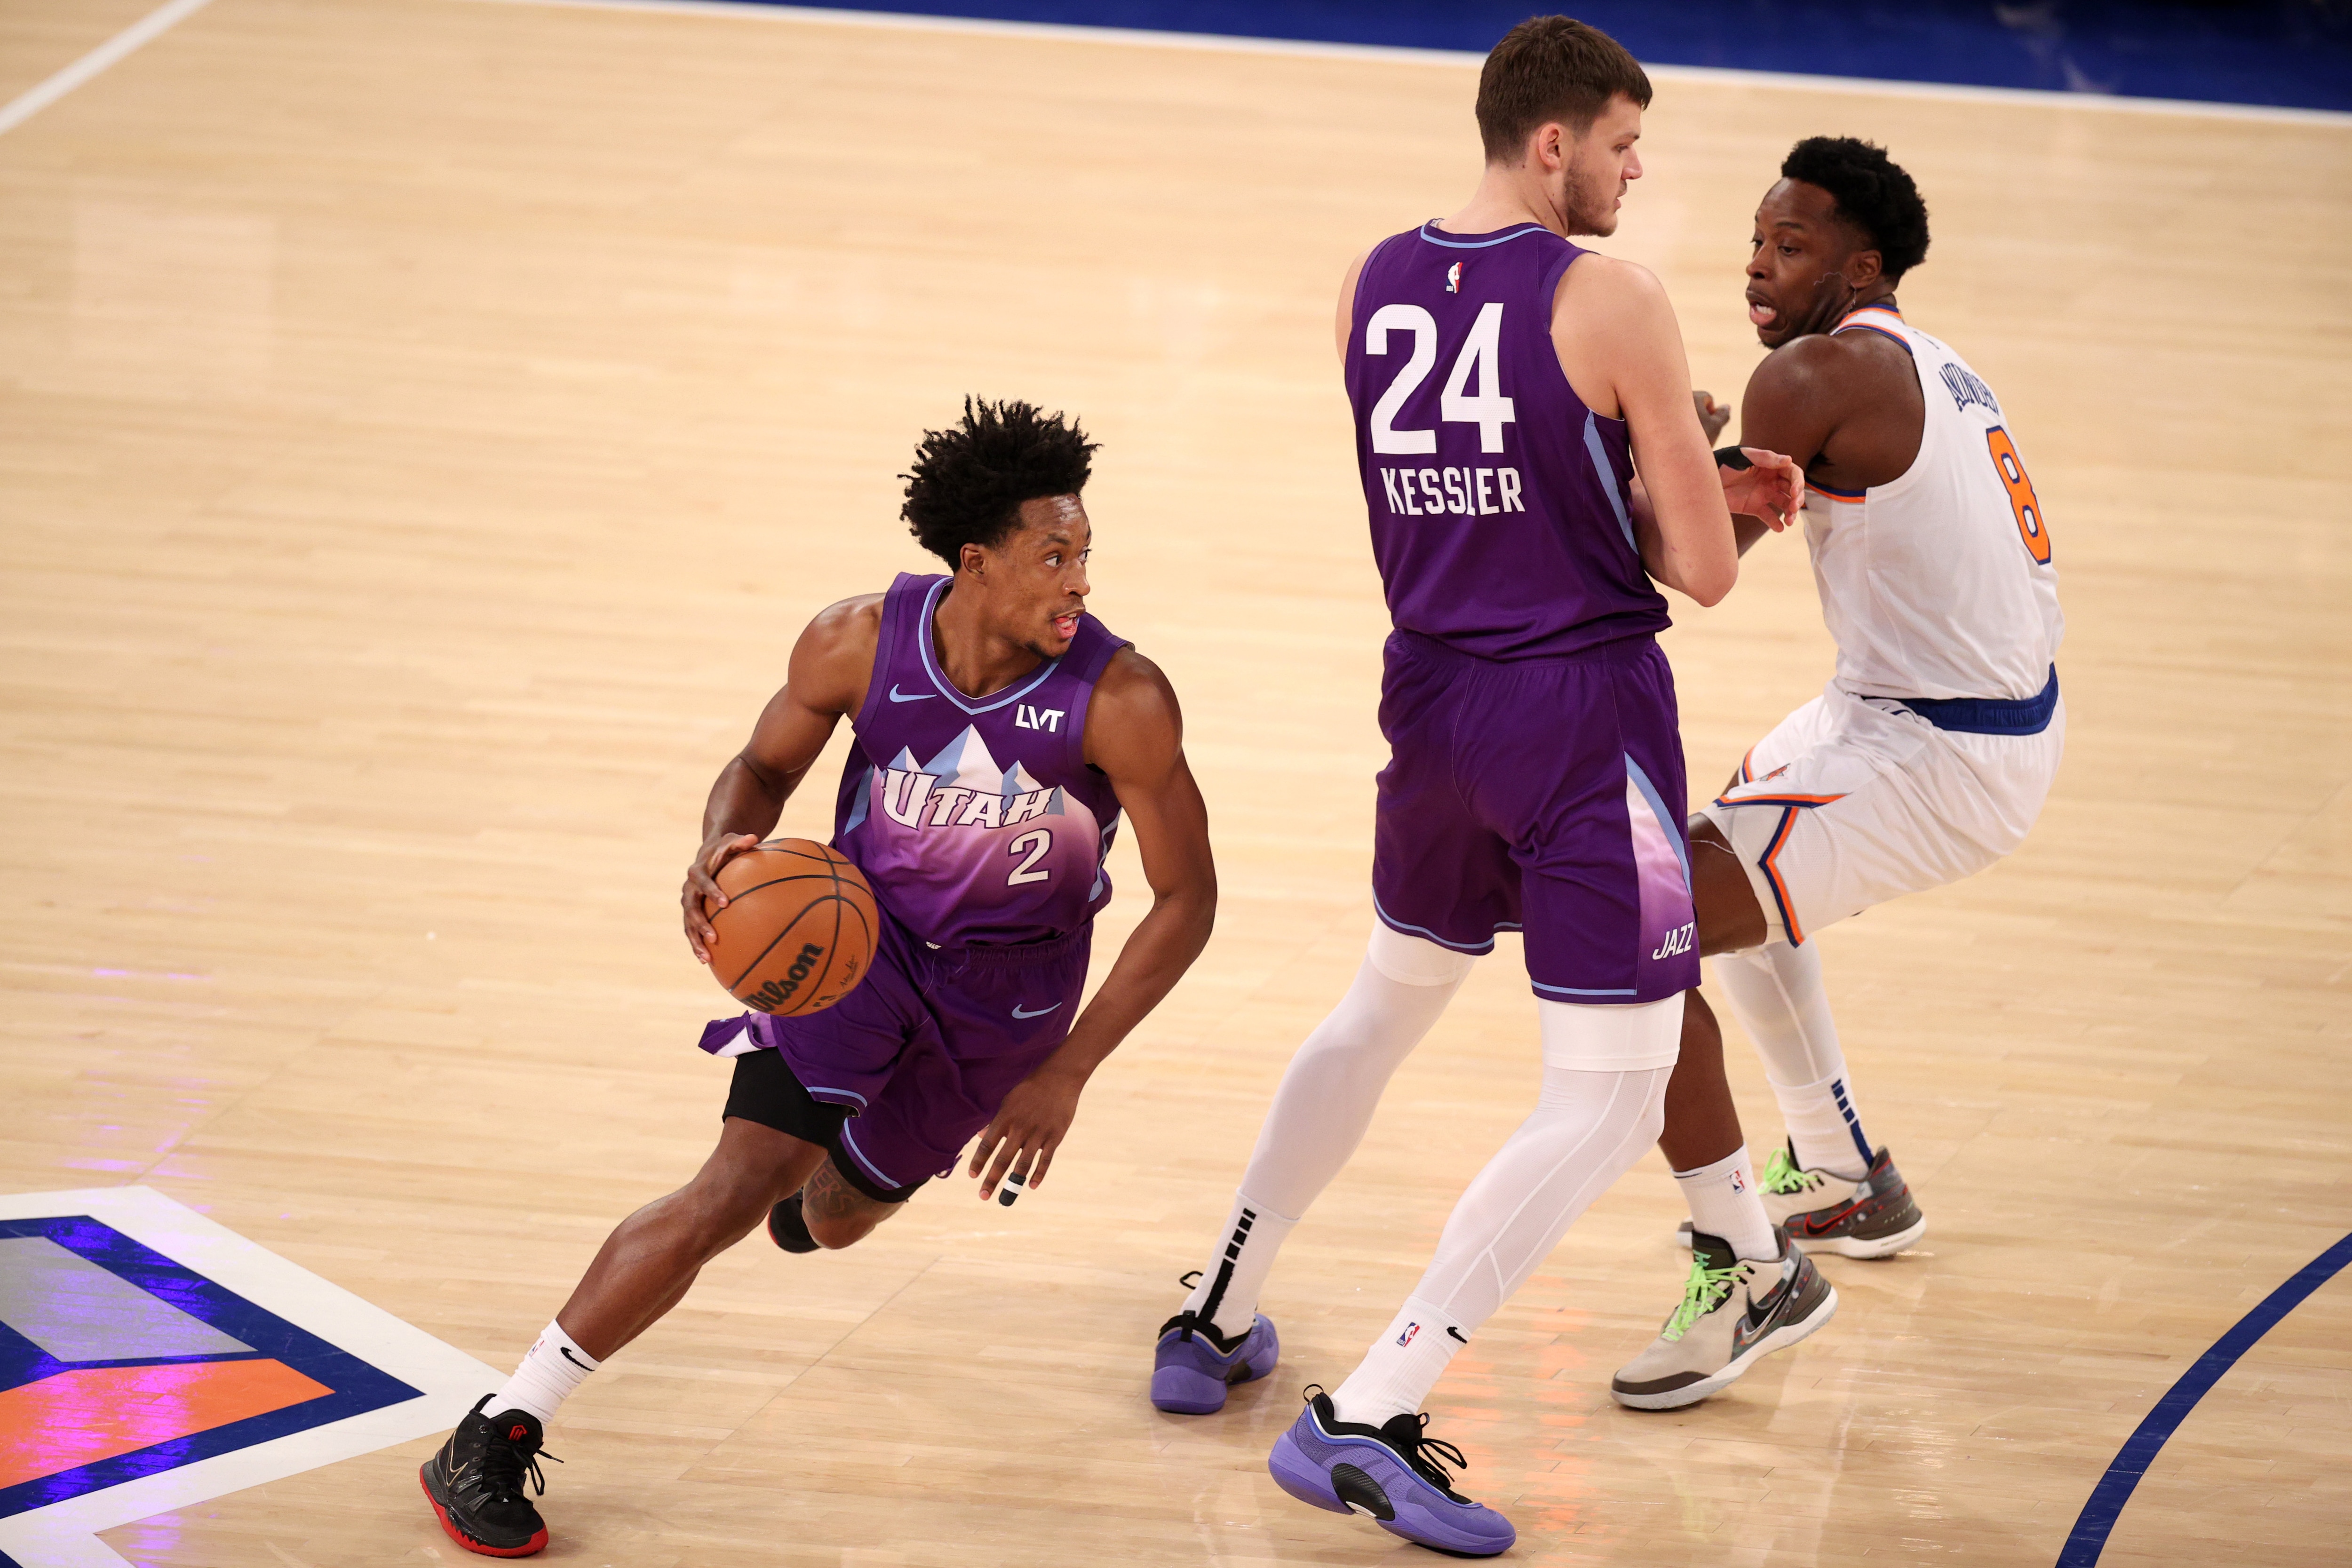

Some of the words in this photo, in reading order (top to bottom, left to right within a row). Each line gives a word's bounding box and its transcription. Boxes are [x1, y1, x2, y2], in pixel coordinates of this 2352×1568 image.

[1366, 302, 1516, 454] 24
[1380, 467, 1526, 517] KESSLER
[1986, 425, 2051, 565] 8
[1015, 704, 1065, 732] LVT
[1007, 828, 1053, 886] 2
[1652, 921, 1694, 960] JAZZ
